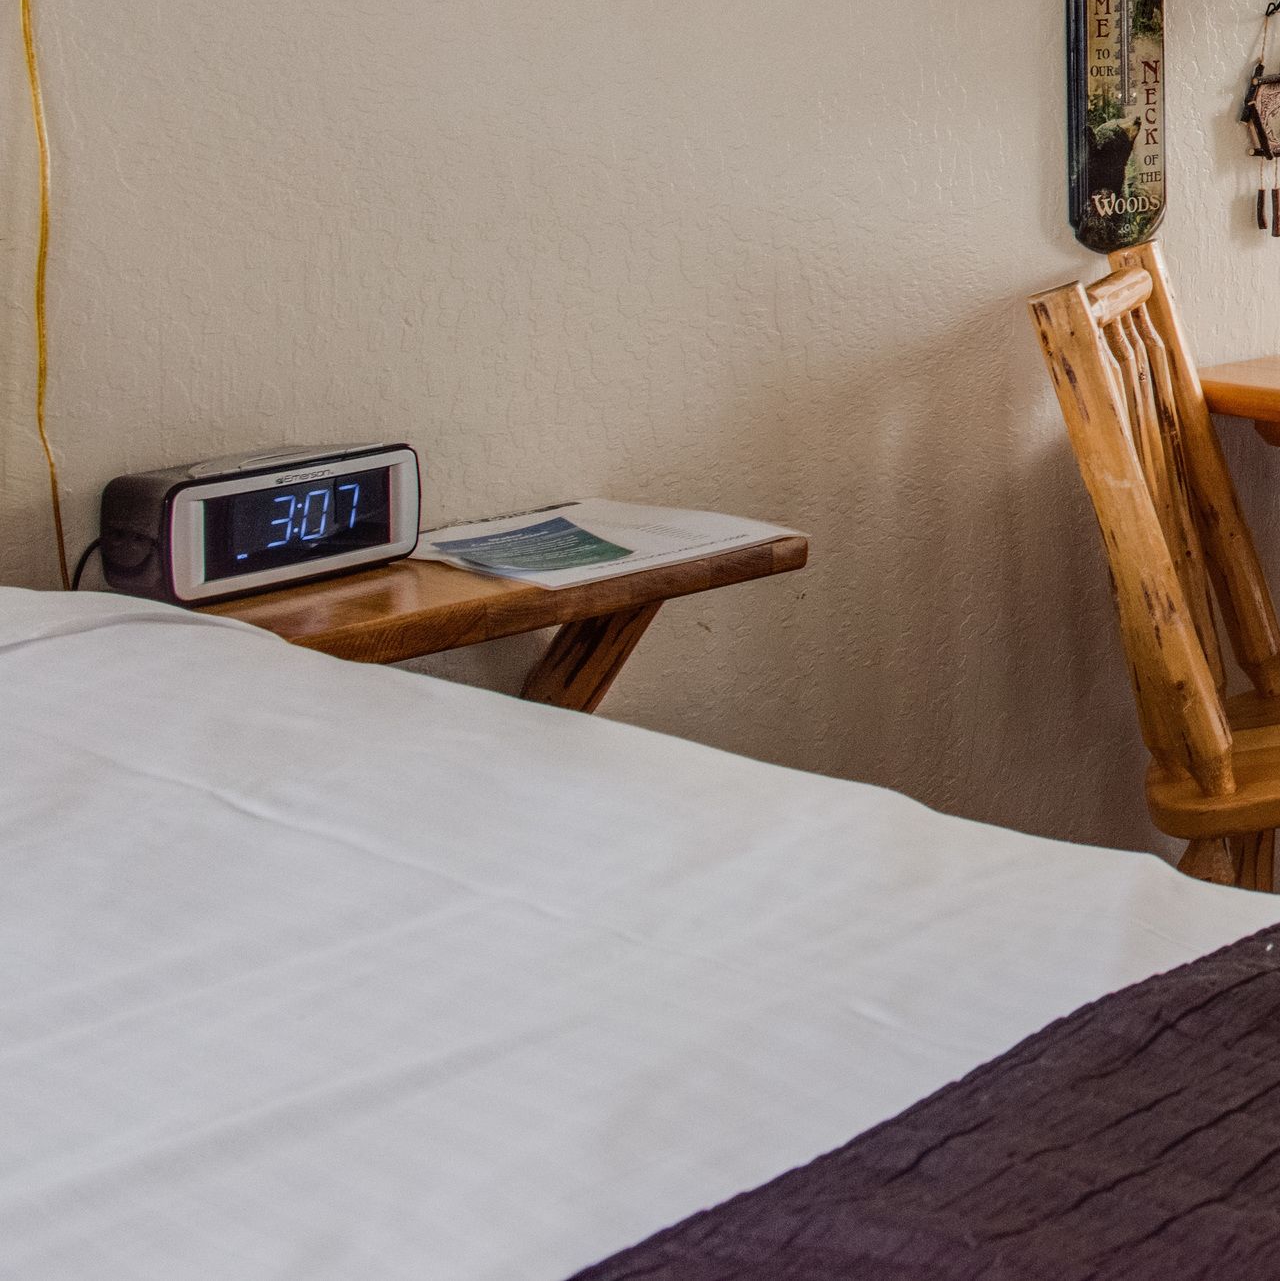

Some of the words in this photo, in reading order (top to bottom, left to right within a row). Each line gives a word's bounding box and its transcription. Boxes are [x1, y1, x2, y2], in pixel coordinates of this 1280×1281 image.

[1095, 48, 1111, 60] TO
[1090, 65, 1115, 77] OUR
[1141, 59, 1160, 146] NECK
[1143, 154, 1159, 166] OF
[1139, 171, 1162, 184] THE
[1091, 192, 1161, 217] WOODS
[284, 469, 331, 483] Emerson
[267, 483, 359, 548] 3:07
